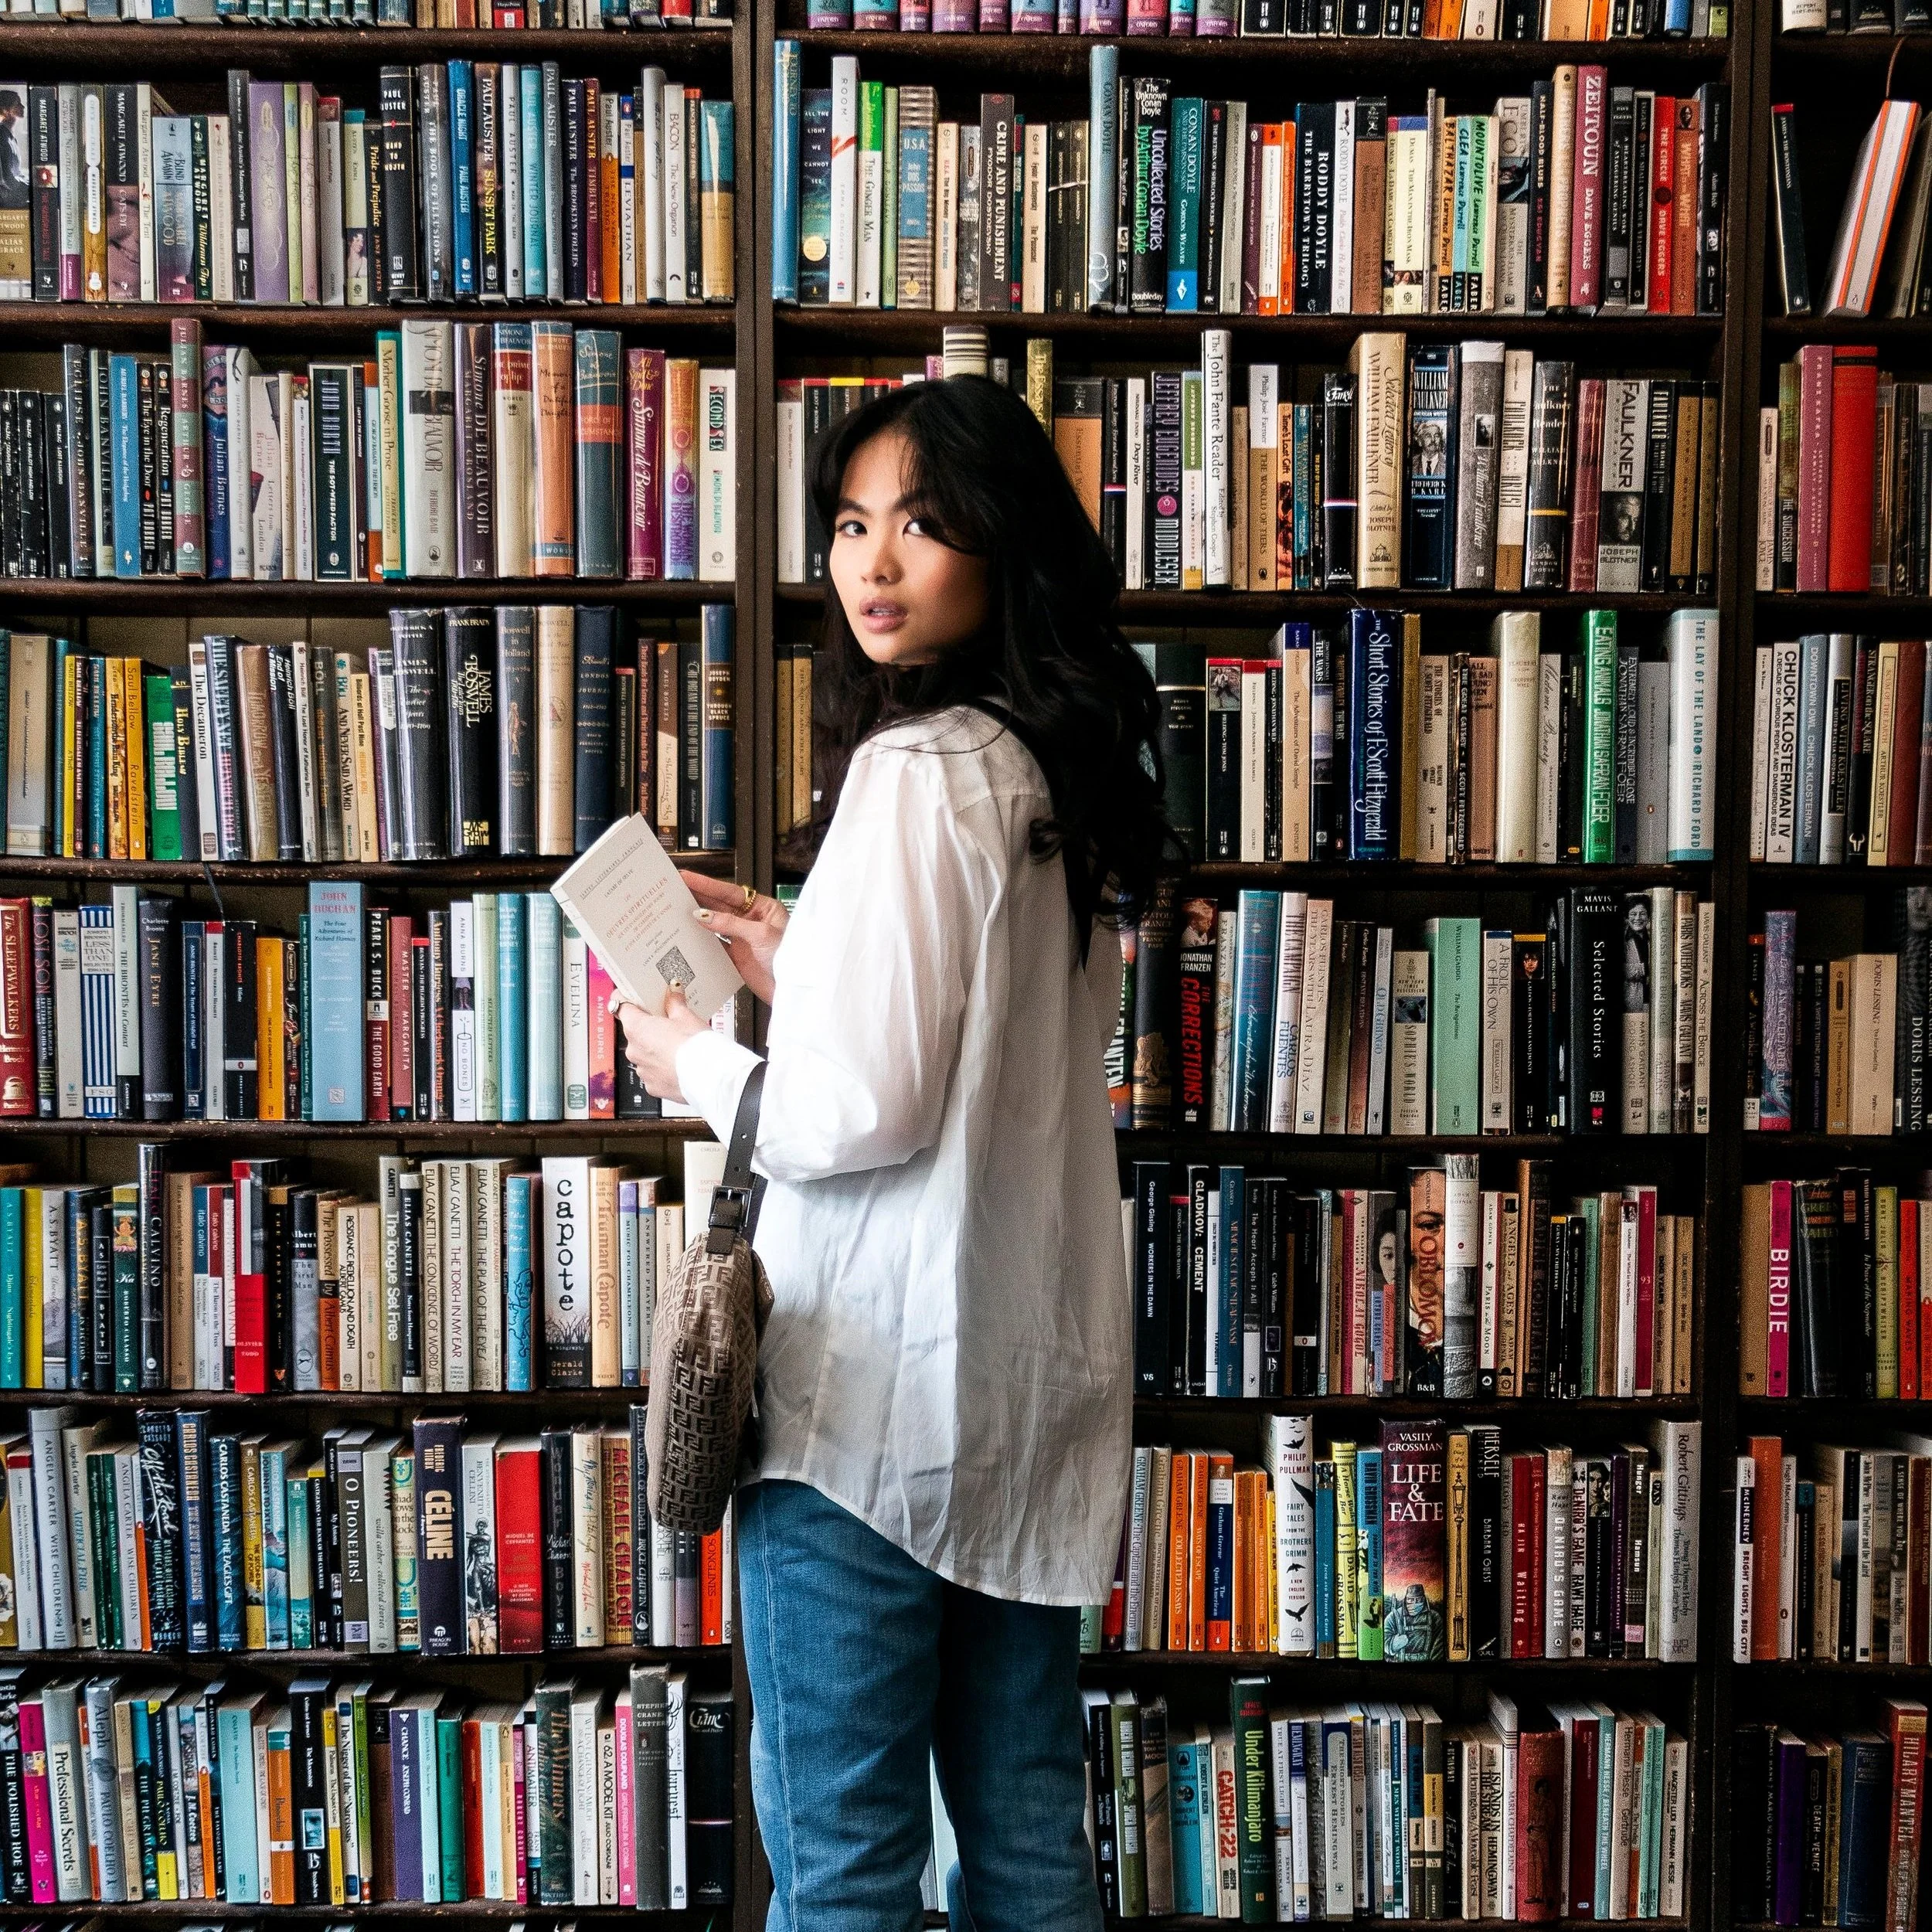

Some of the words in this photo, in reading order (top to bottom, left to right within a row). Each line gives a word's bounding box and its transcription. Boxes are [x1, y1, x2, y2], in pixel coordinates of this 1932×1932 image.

[483, 78, 493, 110] PAUL
[117, 93, 127, 139] MARGARET
[141, 110, 149, 144] Margaret
[669, 114, 679, 151] BACON
[1583, 76, 1602, 176] ZEITOUN
[483, 111, 495, 162] AUSTER
[995, 121, 1006, 165] CRIME
[1304, 131, 1313, 155] THE
[118, 143, 127, 182] ATWOOD
[141, 148, 150, 178] Atwood
[370, 146, 379, 170] Pride
[1137, 141, 1151, 179] Arthur
[1150, 130, 1166, 206] Uncollected
[1473, 121, 1485, 195] MOUNTOLIVE
[484, 170, 495, 219] SUNSET
[995, 168, 1005, 196] AND
[1302, 159, 1313, 232] BARRYTOWN
[1317, 152, 1329, 207] RODDY
[370, 185, 381, 227] Prejudice
[1136, 181, 1149, 216] Conan
[1584, 189, 1594, 219] DAVE
[485, 223, 495, 254] PARK
[624, 182, 634, 262] LEVIATHAN
[994, 199, 1006, 281] PUNISHMENT
[1133, 223, 1150, 254] Doyle
[1149, 209, 1165, 250] Stories
[1315, 215, 1328, 269] DOYLE
[1582, 222, 1593, 270] EGGERS
[1301, 237, 1311, 289] TRILOGY
[1208, 354, 1222, 387] John
[143, 398, 151, 416] The
[1155, 376, 1179, 424] JEFFREY
[1211, 393, 1223, 430] Fante
[140, 418, 151, 435] Eye
[144, 437, 152, 447] in
[158, 406, 170, 476] Regeneration
[631, 398, 653, 450] Simone
[1618, 381, 1640, 488] FAULKNER
[144, 448, 152, 462] the
[634, 451, 651, 468] de
[1155, 430, 1178, 492] EUGENIDES
[1211, 435, 1222, 480] Reader
[144, 464, 154, 487] Door
[634, 471, 651, 530] Beauvoir
[1155, 519, 1178, 584] MIDDLESEX
[1696, 621, 1706, 643] THE
[1369, 632, 1392, 670] Short
[1695, 646, 1705, 668] LAY
[128, 668, 137, 691] Saul
[195, 672, 206, 692] The
[466, 655, 479, 727] BOSWELL
[478, 670, 491, 713] JAMES
[1368, 673, 1389, 716] Stories
[1695, 671, 1704, 685] OF
[1782, 651, 1796, 706] CHUCK
[128, 695, 137, 729] Bellow
[1694, 690, 1703, 711] THE
[197, 696, 209, 759] Decameron
[1366, 722, 1388, 736] of
[1693, 715, 1703, 745] LAND
[1366, 747, 1388, 781] Scott
[1779, 712, 1795, 819] KLOSTERMAN
[130, 764, 140, 825] Ravelstein
[1692, 764, 1702, 813] RICHARD
[1355, 784, 1386, 841] Fitzgerald
[1778, 824, 1790, 838] IV
[1691, 818, 1701, 848] FORD
[372, 913, 383, 947] PEARL
[149, 938, 161, 968] JANE
[372, 954, 382, 964] S.
[1593, 941, 1604, 1002] Selected
[5, 935, 19, 1031] SLEEPWALKERS
[150, 975, 162, 1007] EYRE
[372, 970, 383, 998] BUCK
[570, 963, 582, 1028] EVELINA
[372, 1026, 383, 1041] THE
[1181, 978, 1203, 1104] CORRECTIONS
[1593, 1009, 1604, 1059] Stories
[1911, 1017, 1923, 1063] DORIS
[372, 1045, 383, 1063] GOOD
[372, 1071, 383, 1097] EARTH
[1910, 1067, 1923, 1131] LESSING
[451, 1167, 461, 1192] ELIAS
[322, 1208, 334, 1226] The
[386, 1212, 400, 1235] The
[450, 1196, 461, 1239] CANETTI
[1195, 1180, 1204, 1236] GLADKOV:
[322, 1229, 335, 1276] Possessed
[383, 1234, 400, 1284] Tongue
[451, 1247, 461, 1267] THE
[556, 1179, 573, 1311] capote
[451, 1269, 461, 1304] TORCH
[1194, 1247, 1203, 1292] CEMENT
[387, 1287, 399, 1310] Set
[1418, 1236, 1436, 1348] OBLOMOV
[1769, 1248, 1789, 1333] BIRDIE
[323, 1301, 336, 1328] Albert
[388, 1313, 399, 1341] Free
[452, 1306, 461, 1316] IN
[452, 1319, 462, 1335] MY
[325, 1333, 335, 1372] Camus
[453, 1338, 461, 1358] EAR
[219, 1444, 229, 1478] CARLOS
[1677, 1434, 1692, 1471] Robert
[345, 1478, 359, 1492] O
[1391, 1464, 1442, 1483] LIFE
[1634, 1464, 1644, 1494] Hunger
[221, 1481, 232, 1534] CASTANEDA
[1408, 1484, 1423, 1502] &
[1675, 1475, 1689, 1521] Gittings
[426, 1491, 454, 1560] CÉLINE
[1388, 1503, 1444, 1522] FATE
[1633, 1539, 1641, 1573] Hamsun
[6, 1753, 17, 1778] THE
[1244, 1730, 1264, 1767] Under
[1900, 1737, 1919, 1784] HILARY
[55, 1751, 72, 1824] Professional
[527, 1745, 536, 1808] ANTIMATTER
[604, 1770, 614, 1804] MODEL
[7, 1781, 20, 1838] POLISHED
[604, 1806, 614, 1820] KIT
[1244, 1770, 1266, 1842] Kilimanjaro
[1897, 1789, 1917, 1841] MANTEL
[12, 1842, 22, 1866] HOE
[60, 1828, 77, 1872] Secrets
